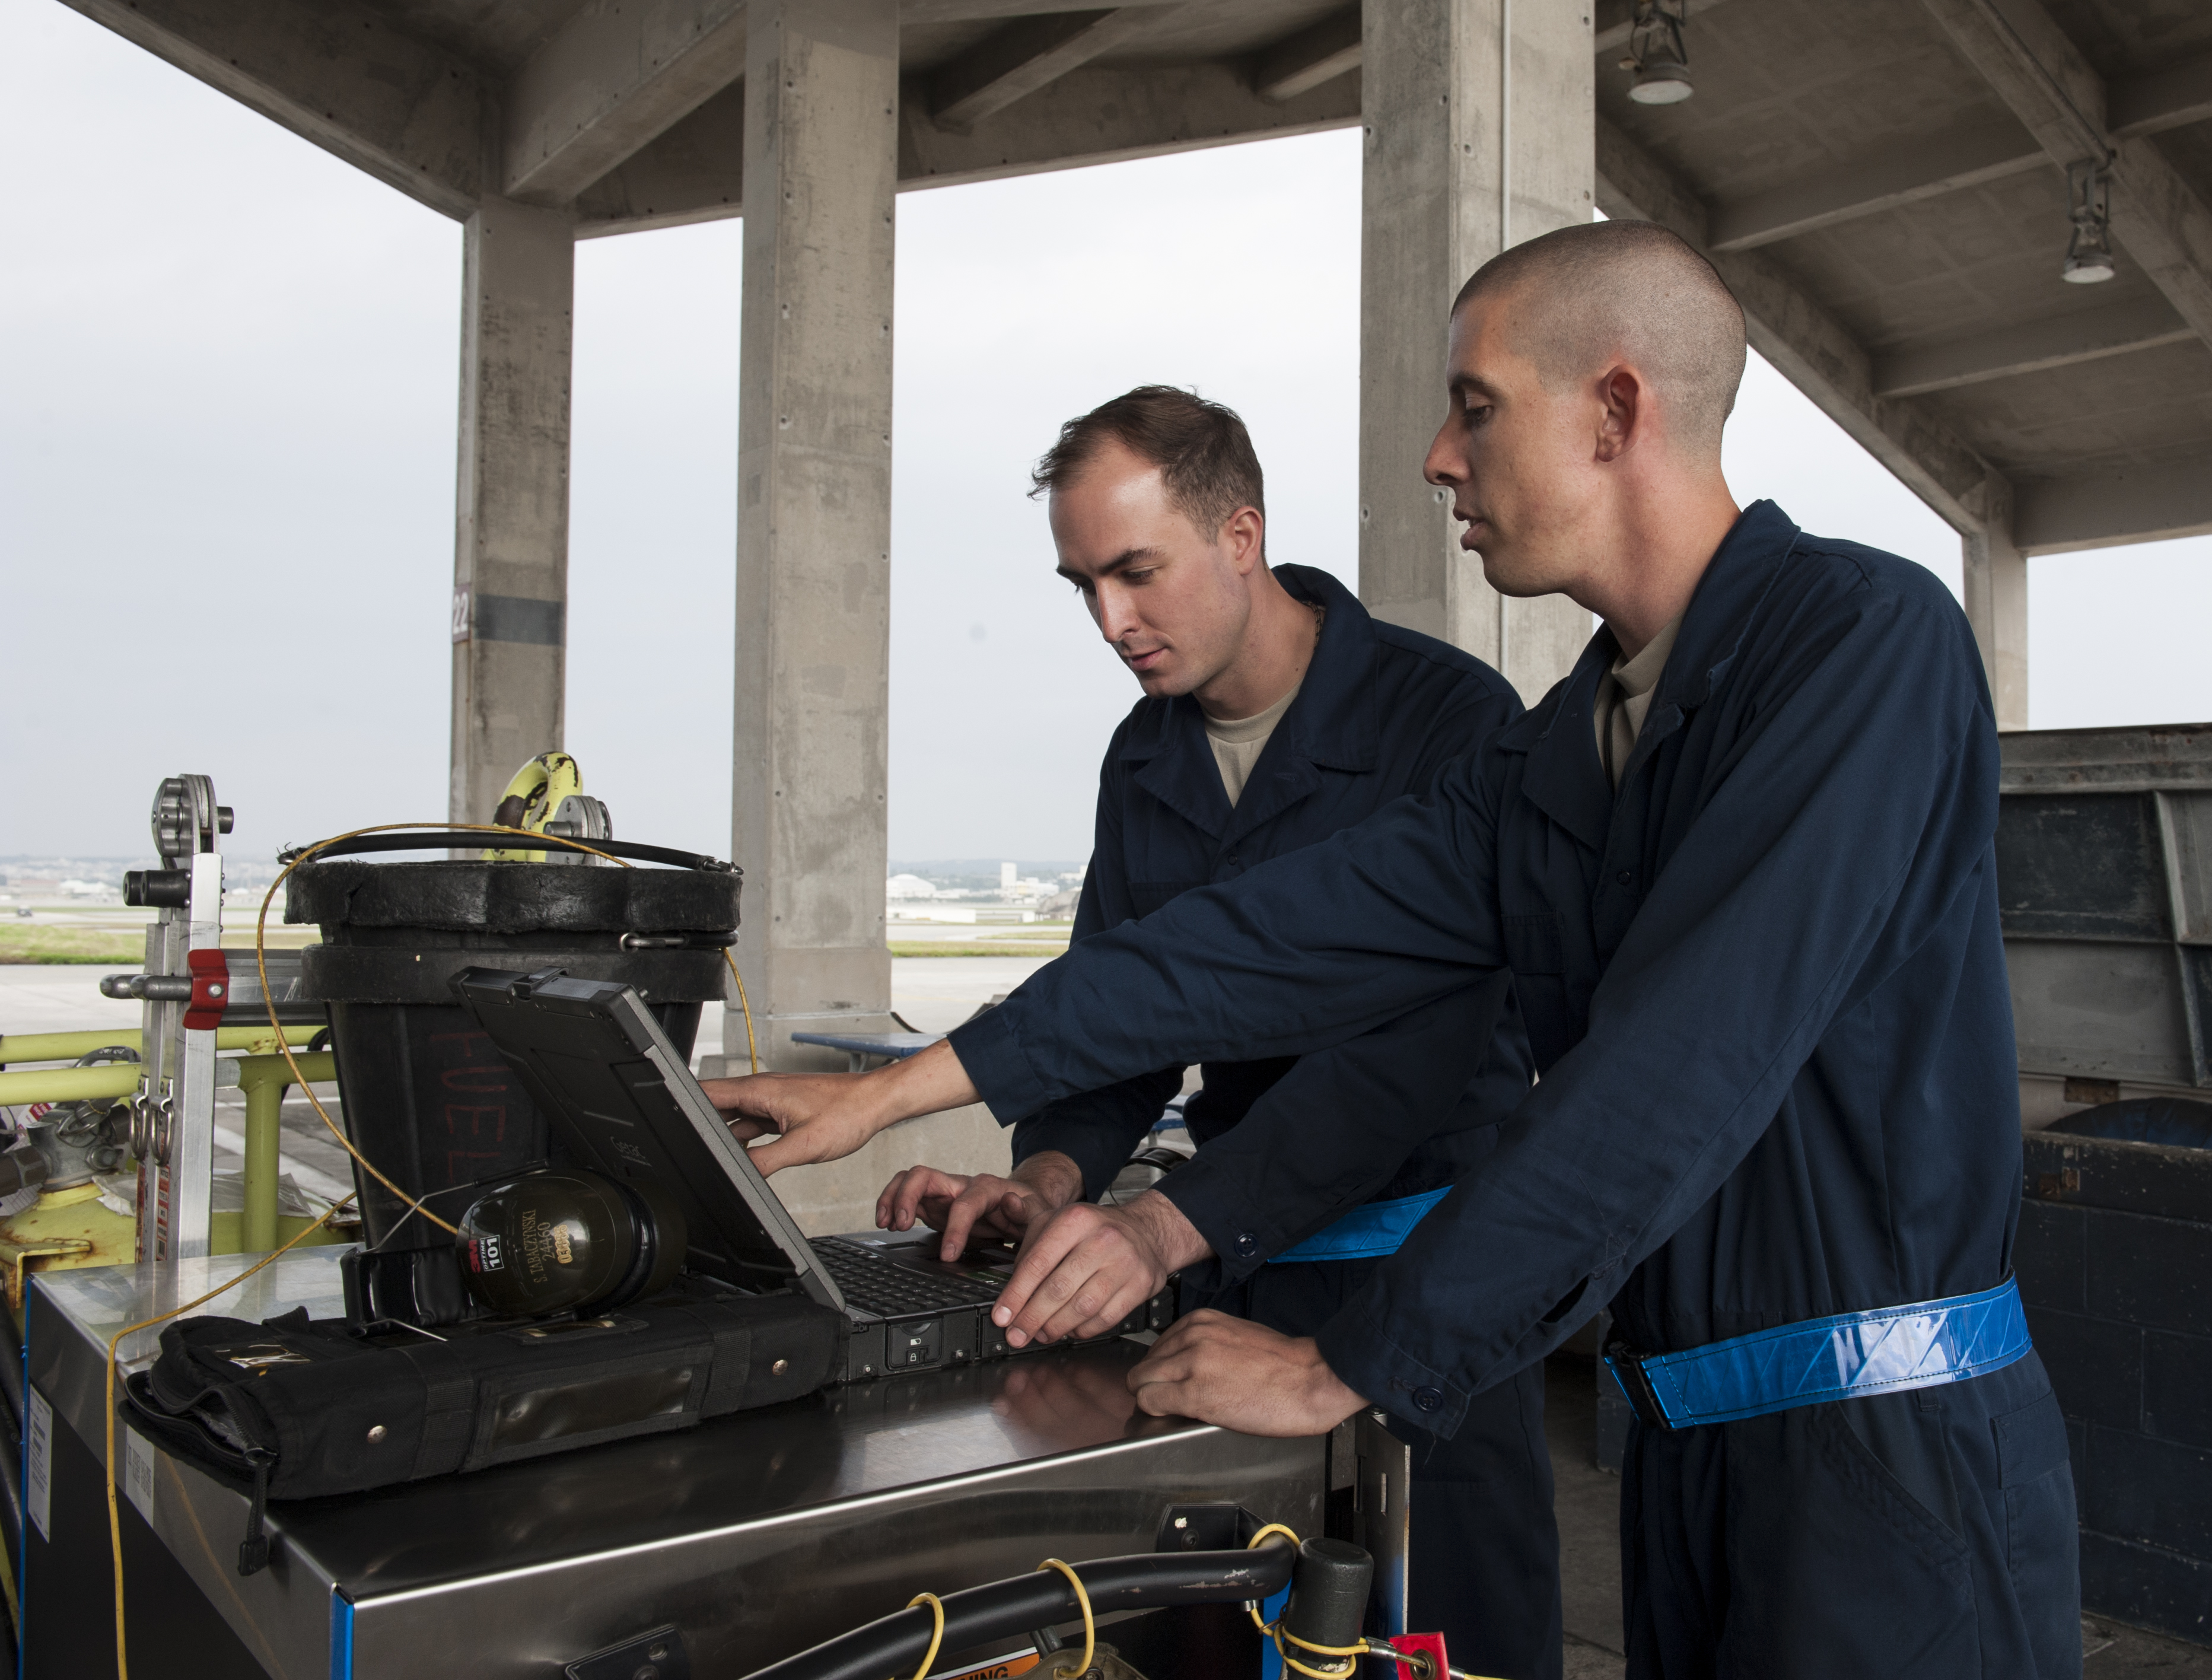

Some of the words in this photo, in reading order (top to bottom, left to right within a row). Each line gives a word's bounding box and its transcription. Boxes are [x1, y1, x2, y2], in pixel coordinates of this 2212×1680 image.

[453, 592, 469, 634] 22
[431, 1032, 511, 1184] FUEL
[610, 1136, 646, 1159] Getac
[469, 1239, 481, 1273] 3M
[488, 1237, 500, 1268] 101
[523, 1208, 544, 1275] TABACZYNSKI
[537, 1221, 556, 1261] 24460
[534, 1274, 548, 1284] S.
